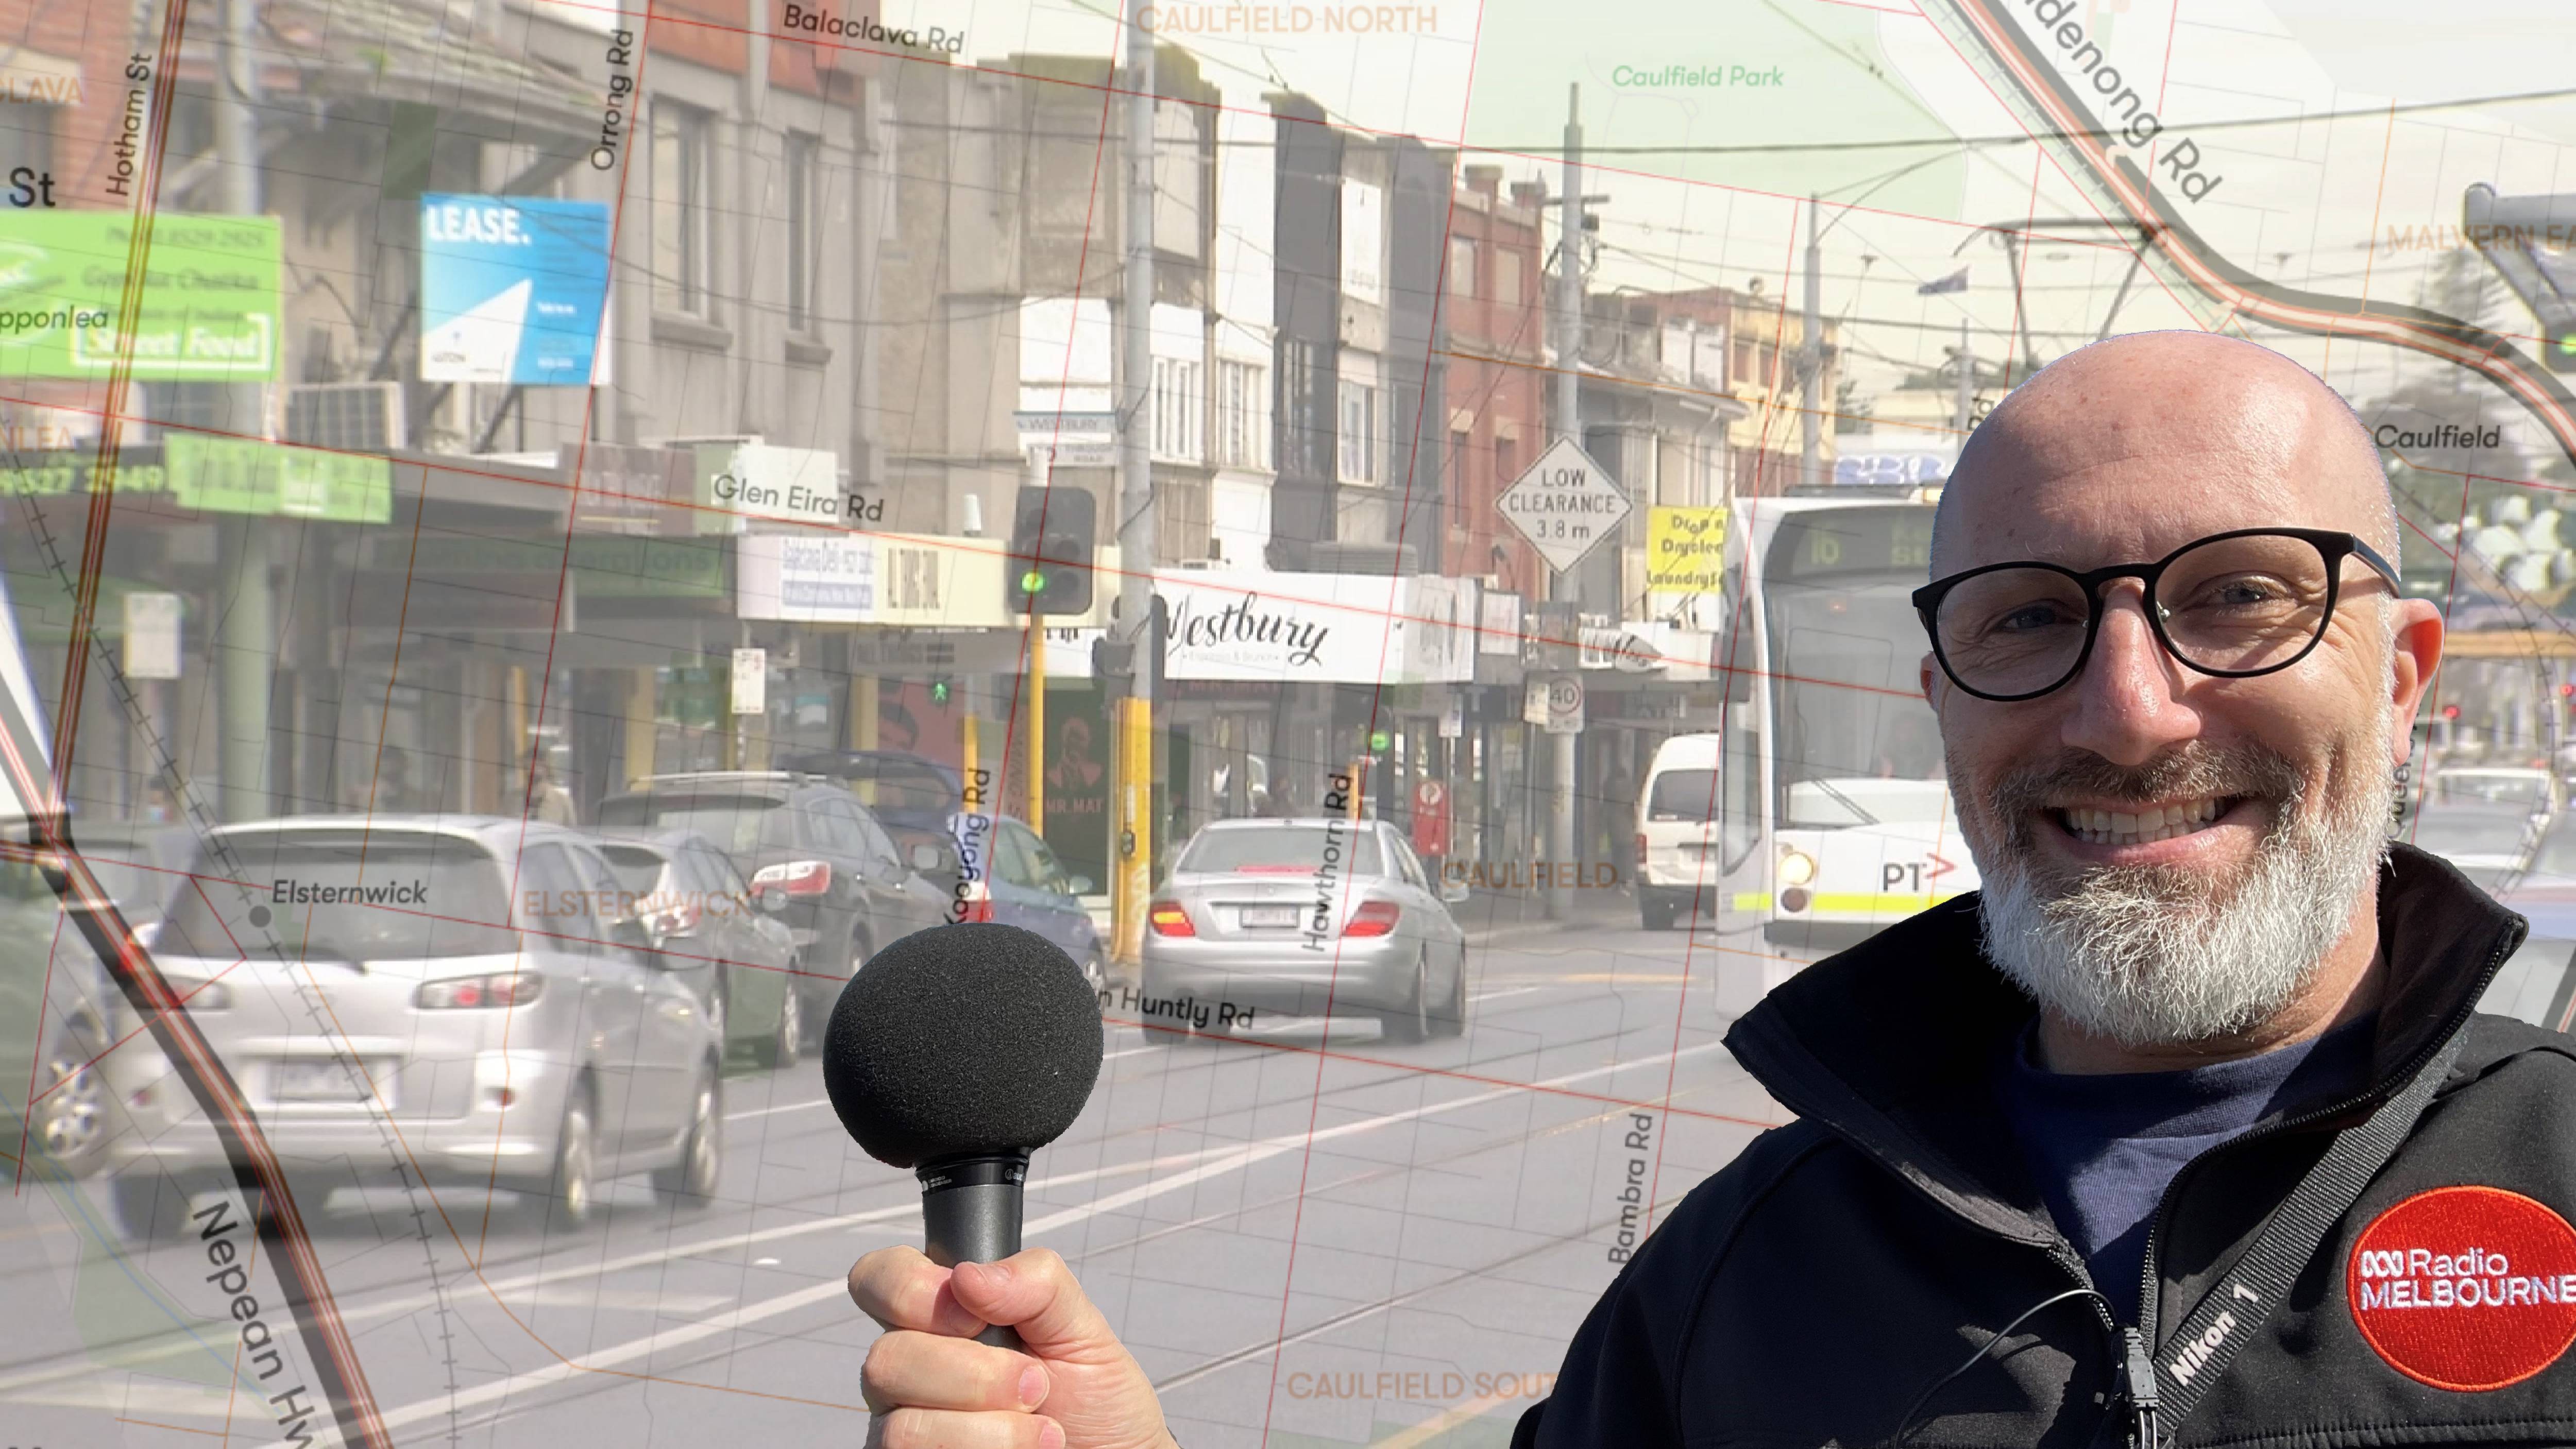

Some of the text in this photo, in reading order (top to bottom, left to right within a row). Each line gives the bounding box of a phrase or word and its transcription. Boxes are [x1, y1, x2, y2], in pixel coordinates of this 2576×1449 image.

[426, 204, 532, 246] LEASE.
[1541, 468, 1584, 487] LOW
[1509, 494, 1616, 514] CLEARANCE
[1537, 520, 1590, 538] 3.8 m
[2409, 1248, 2509, 1277] Radio
[2360, 1274, 2576, 1310] MELBOURNE
[2169, 1284, 2260, 1387] Nikon 1
